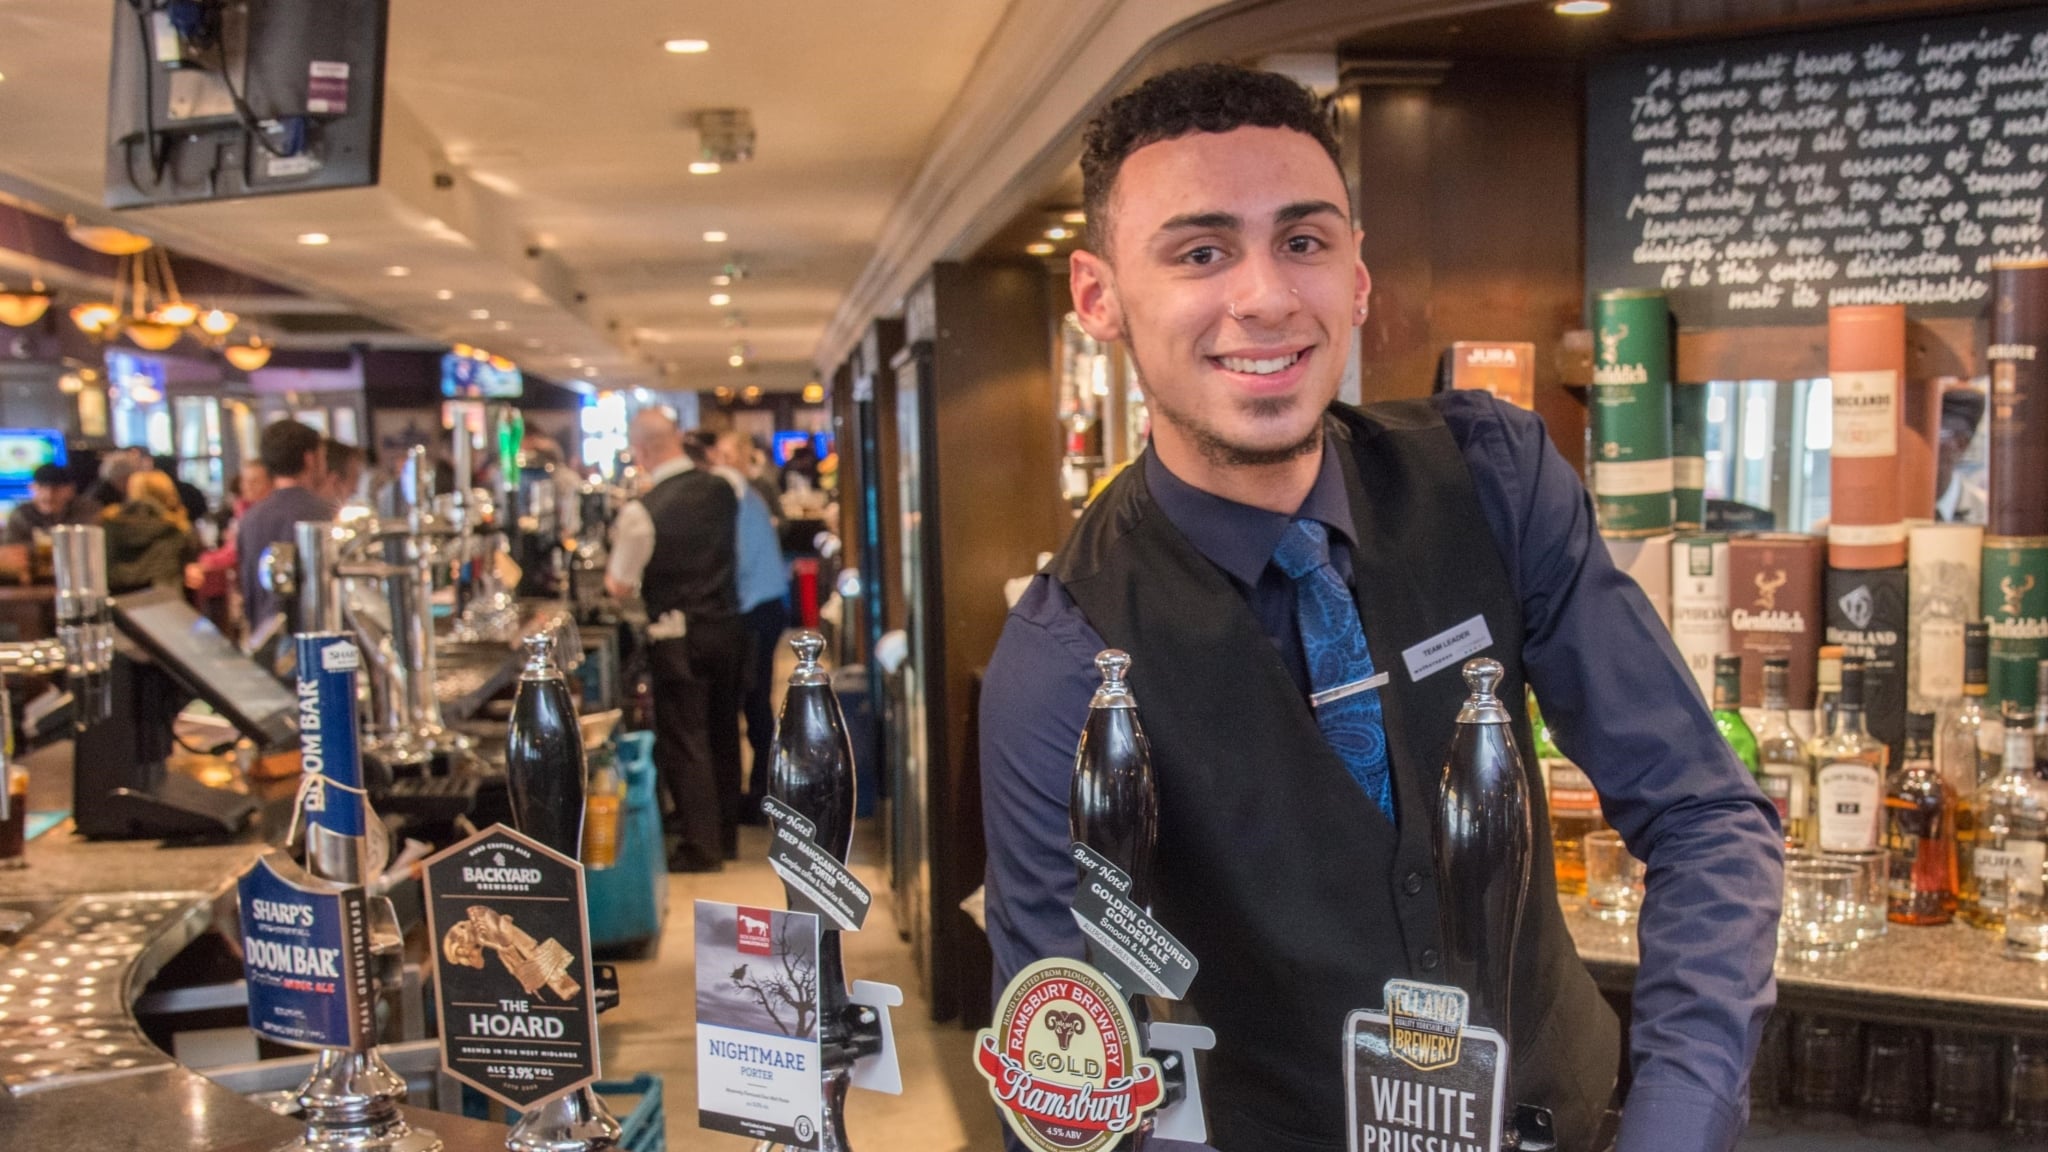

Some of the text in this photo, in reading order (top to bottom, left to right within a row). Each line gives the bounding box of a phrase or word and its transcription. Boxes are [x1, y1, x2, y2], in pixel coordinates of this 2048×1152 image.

[1731, 52, 1790, 82] malt
[1793, 48, 1857, 77] bears
[1863, 41, 1904, 71] the
[1916, 26, 2022, 70] imprint
[1630, 95, 1674, 124] The
[1681, 87, 1750, 113] source
[1759, 80, 1788, 111] of
[1794, 77, 1839, 102] the
[1923, 65, 1967, 93] the
[1632, 113, 1680, 142] and
[1686, 112, 1724, 138] the
[1730, 104, 1838, 136] character
[1844, 101, 1870, 132] of
[1875, 97, 1918, 124] the
[1919, 89, 1985, 126] peat
[1641, 135, 1722, 166] malted
[1729, 132, 1801, 163] barley
[1812, 125, 1848, 154] all
[1857, 121, 1960, 149] combine
[1968, 115, 1993, 142] to
[1733, 162, 1771, 185] the
[1777, 162, 1826, 184] very
[1839, 153, 1932, 178] essence
[1944, 142, 1974, 175] of
[1981, 138, 2017, 168] its
[1626, 191, 1682, 221] Malt
[1686, 185, 1757, 216] whisky
[1764, 182, 1786, 208] is
[1795, 181, 1841, 206] like
[1849, 179, 1888, 202] the
[1895, 172, 1955, 200] Scots
[1642, 215, 1744, 244] language
[1802, 203, 1871, 230] within
[1939, 200, 1969, 223] so
[1976, 196, 2044, 225] many
[1725, 233, 1780, 260] each
[1786, 235, 1827, 257] one
[1833, 226, 1914, 257] unique
[1920, 222, 1947, 250] to
[1955, 218, 1987, 247] its
[1990, 222, 2046, 246] own
[1660, 262, 1686, 289] It
[1689, 258, 1712, 287] is
[1717, 258, 1763, 285] this
[1768, 254, 1839, 283] subtle
[1846, 249, 1963, 279] distinction
[1728, 276, 1990, 309] malt its unmistakable
[1467, 348, 1517, 366] JURA
[1731, 608, 1806, 632] Glenfiddich
[1826, 626, 1897, 646] HIGHLAND
[1423, 630, 1470, 656] TEAM LEADER
[298, 678, 320, 730] BAR
[763, 801, 814, 838] Beer Notes
[487, 843, 514, 851] CRAFTED
[462, 866, 543, 885] BACKYARD
[777, 827, 799, 846] DEEP
[797, 840, 838, 876] MAHOGANY
[836, 871, 870, 905] COLOURED
[809, 862, 837, 888] PORTER
[1073, 848, 1130, 892] Beer Notes
[476, 883, 529, 891] BREWHOUSE
[252, 899, 314, 927] SHARP'S
[1091, 882, 1192, 970] GOLDEN COLOURED
[350, 900, 368, 995] ESTABLISHED
[1099, 917, 1162, 975] Smooth & hoppy.
[1105, 906, 1171, 965] GOLDEN ALE
[245, 936, 293, 973] DOOM
[499, 999, 529, 1013] THE
[1003, 1003, 1015, 1026] HAND
[1015, 975, 1040, 1001] CRAFTED
[1041, 969, 1061, 979] FROM
[1063, 969, 1094, 989] PLOUGH
[1094, 985, 1105, 998] TO
[1105, 997, 1118, 1016] PINT
[1116, 1018, 1129, 1045] GLASS
[1011, 983, 1120, 1066] RAMSBURY BREWERY
[1395, 989, 1459, 1023] ELLAND
[469, 1013, 565, 1039] HOARD
[1395, 1018, 1415, 1028] QUALITY
[1416, 1021, 1443, 1032] YORKSHIRE
[461, 1046, 491, 1054] BREWED
[504, 1048, 518, 1056] THE
[519, 1049, 538, 1057] WEST
[541, 1050, 578, 1059] MIDLANDS
[709, 1039, 806, 1072] NIGHTMARE
[1028, 1050, 1102, 1079] GOLD
[1395, 1029, 1455, 1064] BREWERY
[486, 1065, 554, 1080] ALC 3.9% VOL
[740, 1066, 774, 1080] PORTER
[995, 1054, 1135, 1131] Ramsbury
[1370, 1075, 1476, 1139] WHITE
[1046, 1127, 1065, 1138] 4.5%
[1065, 1130, 1082, 1140] ABV
